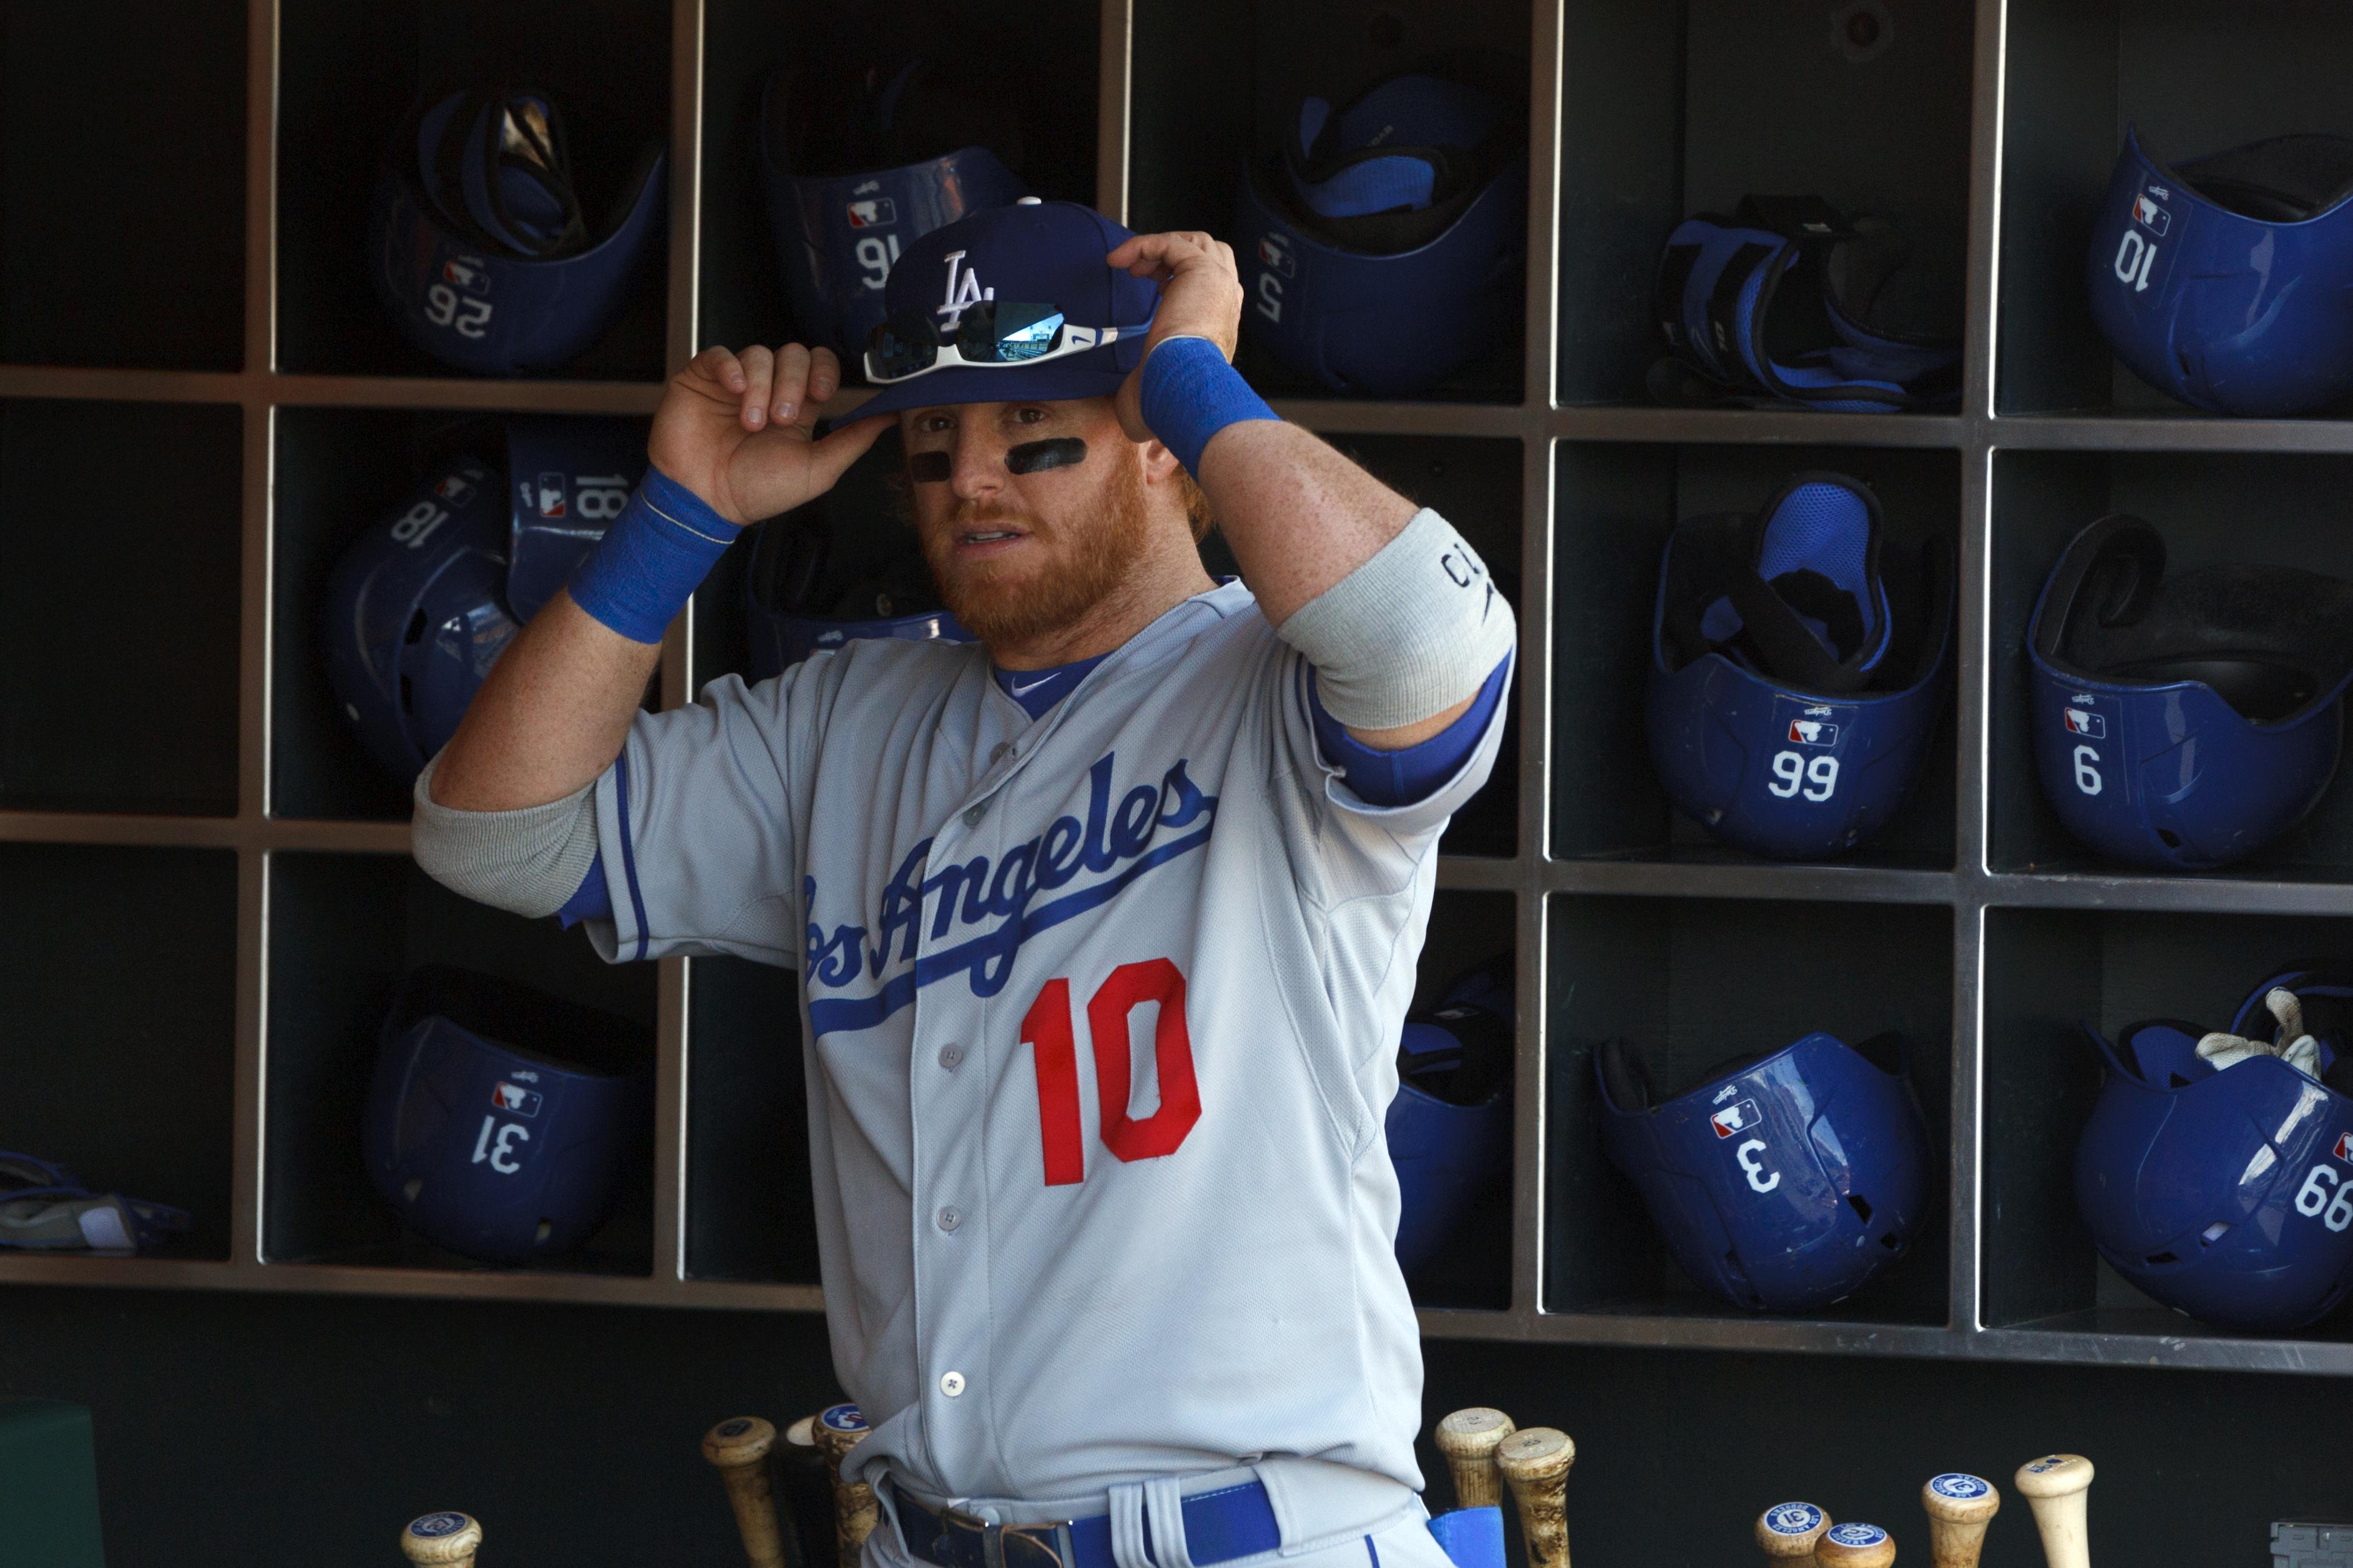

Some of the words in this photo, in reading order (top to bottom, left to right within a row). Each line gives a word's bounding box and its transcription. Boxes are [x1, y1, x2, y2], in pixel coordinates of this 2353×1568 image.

[2115, 229, 2158, 292] 10
[426, 284, 492, 338] 26
[937, 250, 994, 333] LA
[1257, 272, 1283, 323] 5
[391, 501, 449, 548] 18
[576, 476, 628, 519] 18
[1768, 750, 1840, 802] 66
[870, 751, 1218, 997] Angeles
[1020, 958, 1203, 1187] 10
[472, 1115, 529, 1174] 31
[1736, 1138, 1781, 1193] 3
[1783, 1511, 1805, 1524] 31
